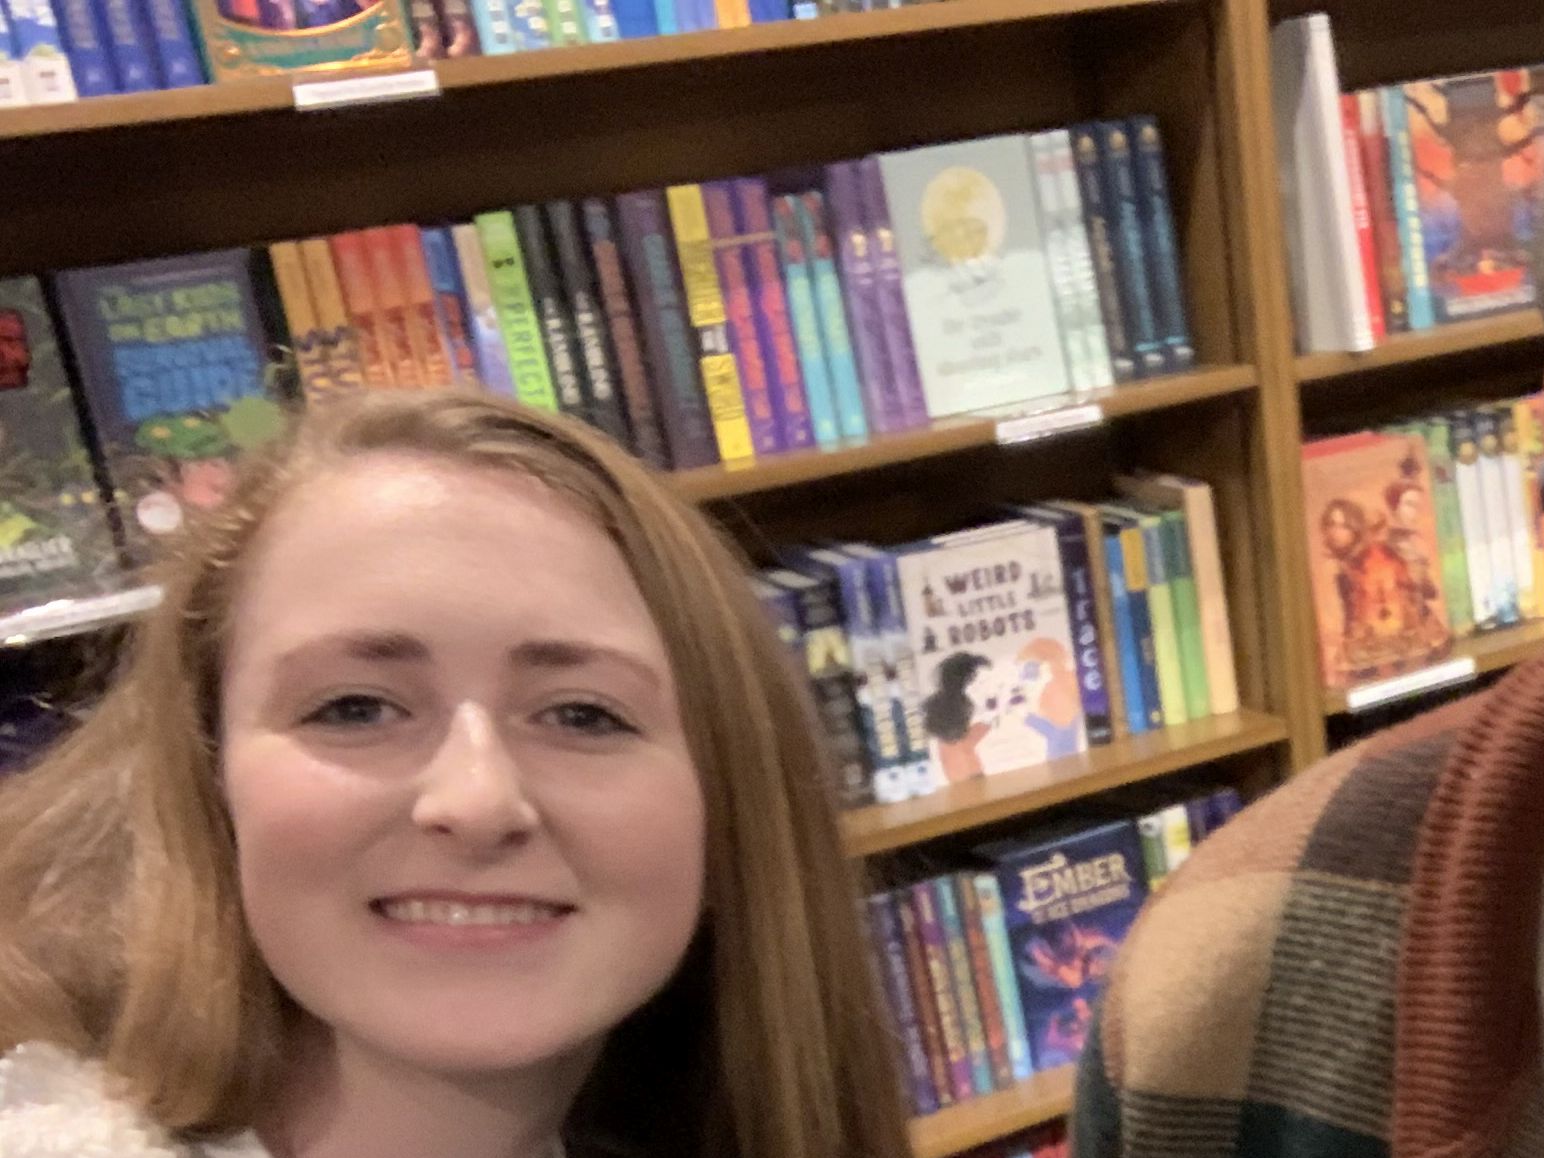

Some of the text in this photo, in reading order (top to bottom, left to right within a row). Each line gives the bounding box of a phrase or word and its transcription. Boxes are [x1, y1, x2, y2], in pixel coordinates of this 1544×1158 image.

[945, 560, 1022, 595] WEIRD
[957, 590, 1017, 618] LITTLE
[947, 608, 1036, 646] ROBOTS
